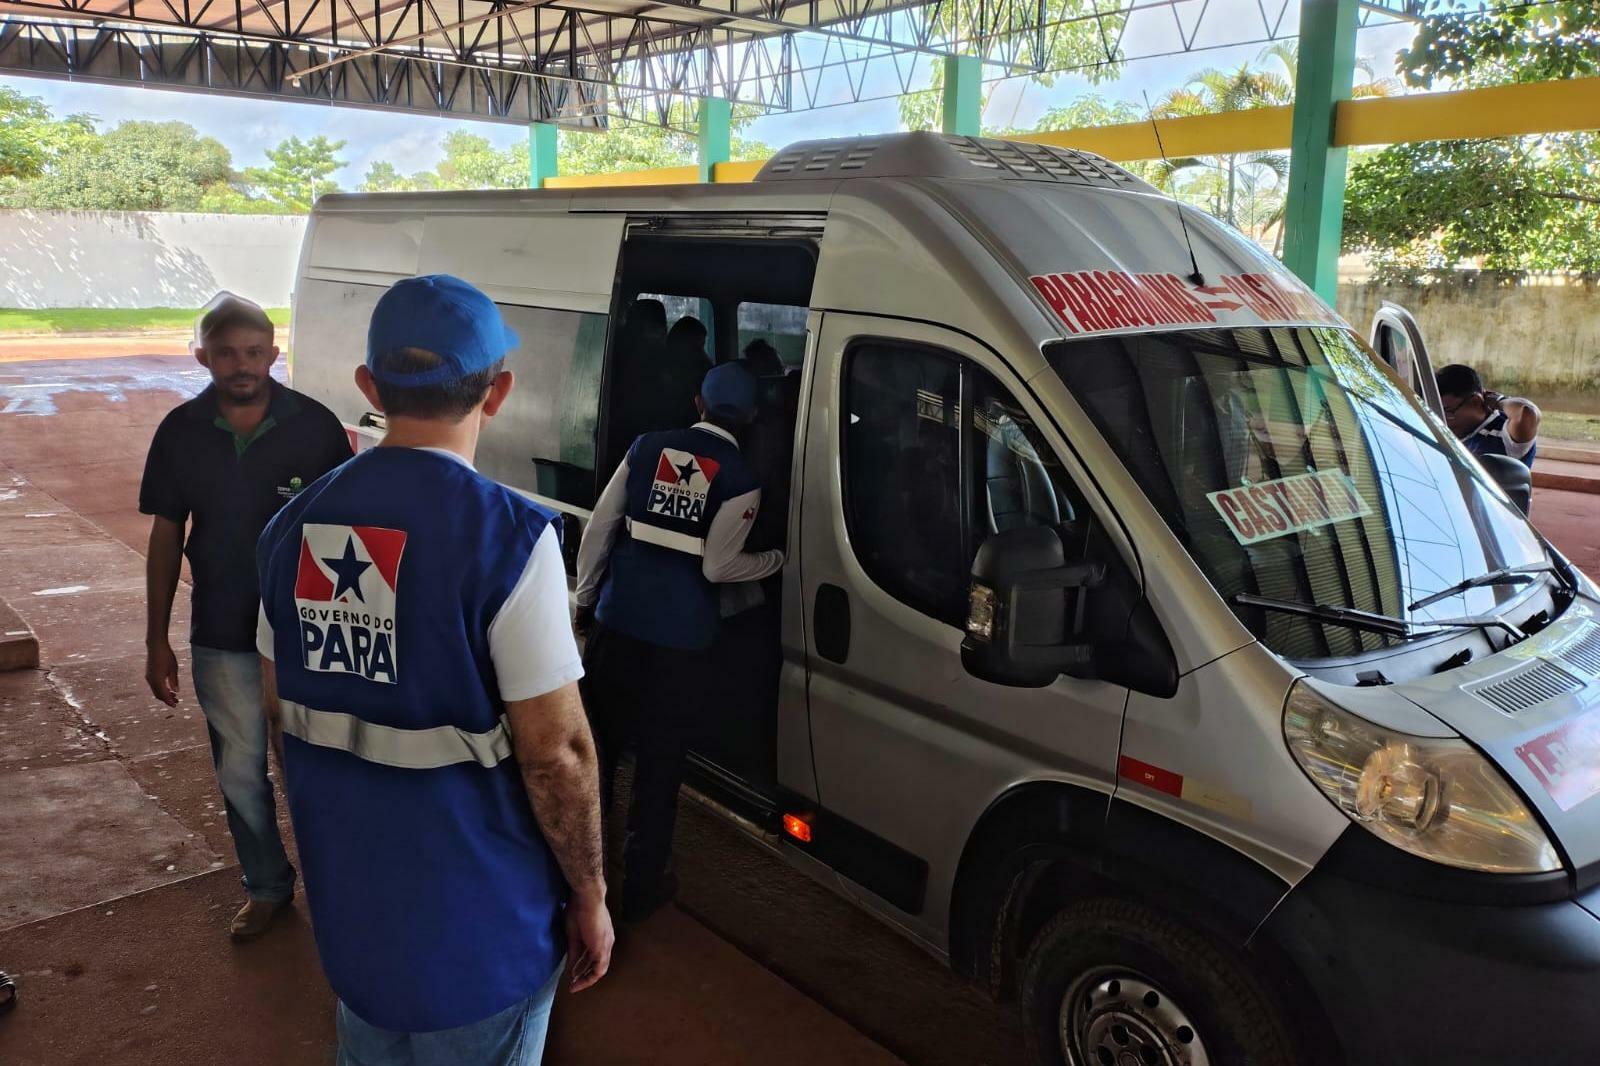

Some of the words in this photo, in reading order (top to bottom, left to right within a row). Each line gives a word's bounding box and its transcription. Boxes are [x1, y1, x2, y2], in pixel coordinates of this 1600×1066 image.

[1029, 270, 1218, 334] PARAGOMINAS
[300, 607, 371, 626] GOVERNO
[374, 617, 394, 631] DO
